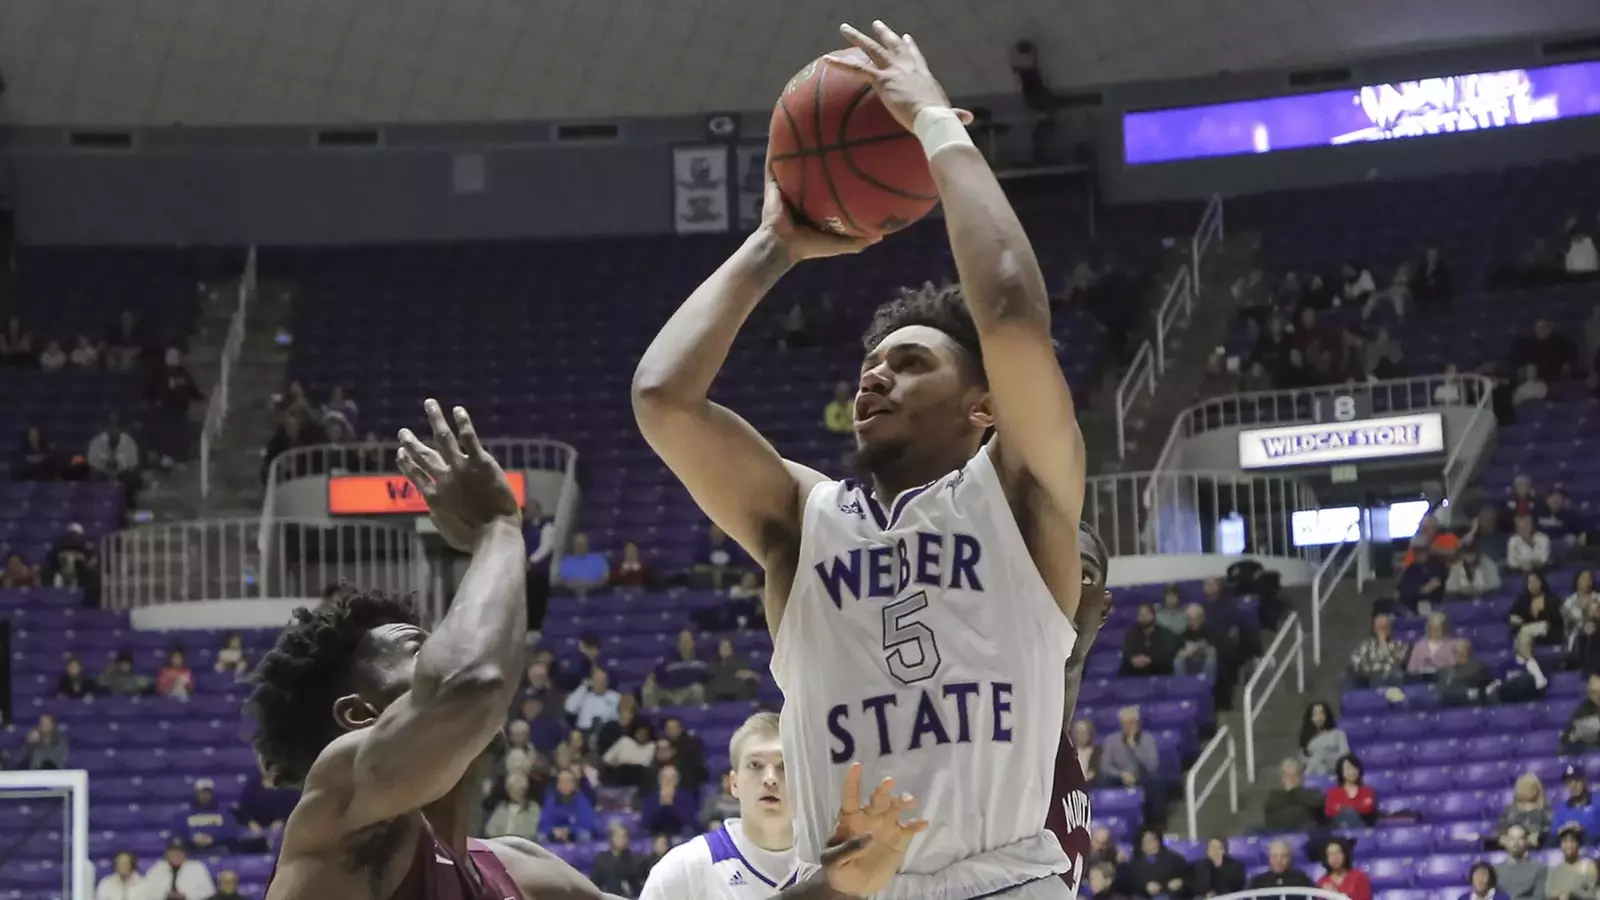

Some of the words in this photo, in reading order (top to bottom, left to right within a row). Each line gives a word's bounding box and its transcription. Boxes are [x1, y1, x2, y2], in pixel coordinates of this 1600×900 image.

[1261, 430, 1351, 458] WILDCAT
[1354, 423, 1422, 447] STORE
[1334, 396, 1355, 421] 8
[814, 531, 985, 611] WEBER
[882, 590, 941, 685] 5
[827, 682, 1013, 764] STATE
